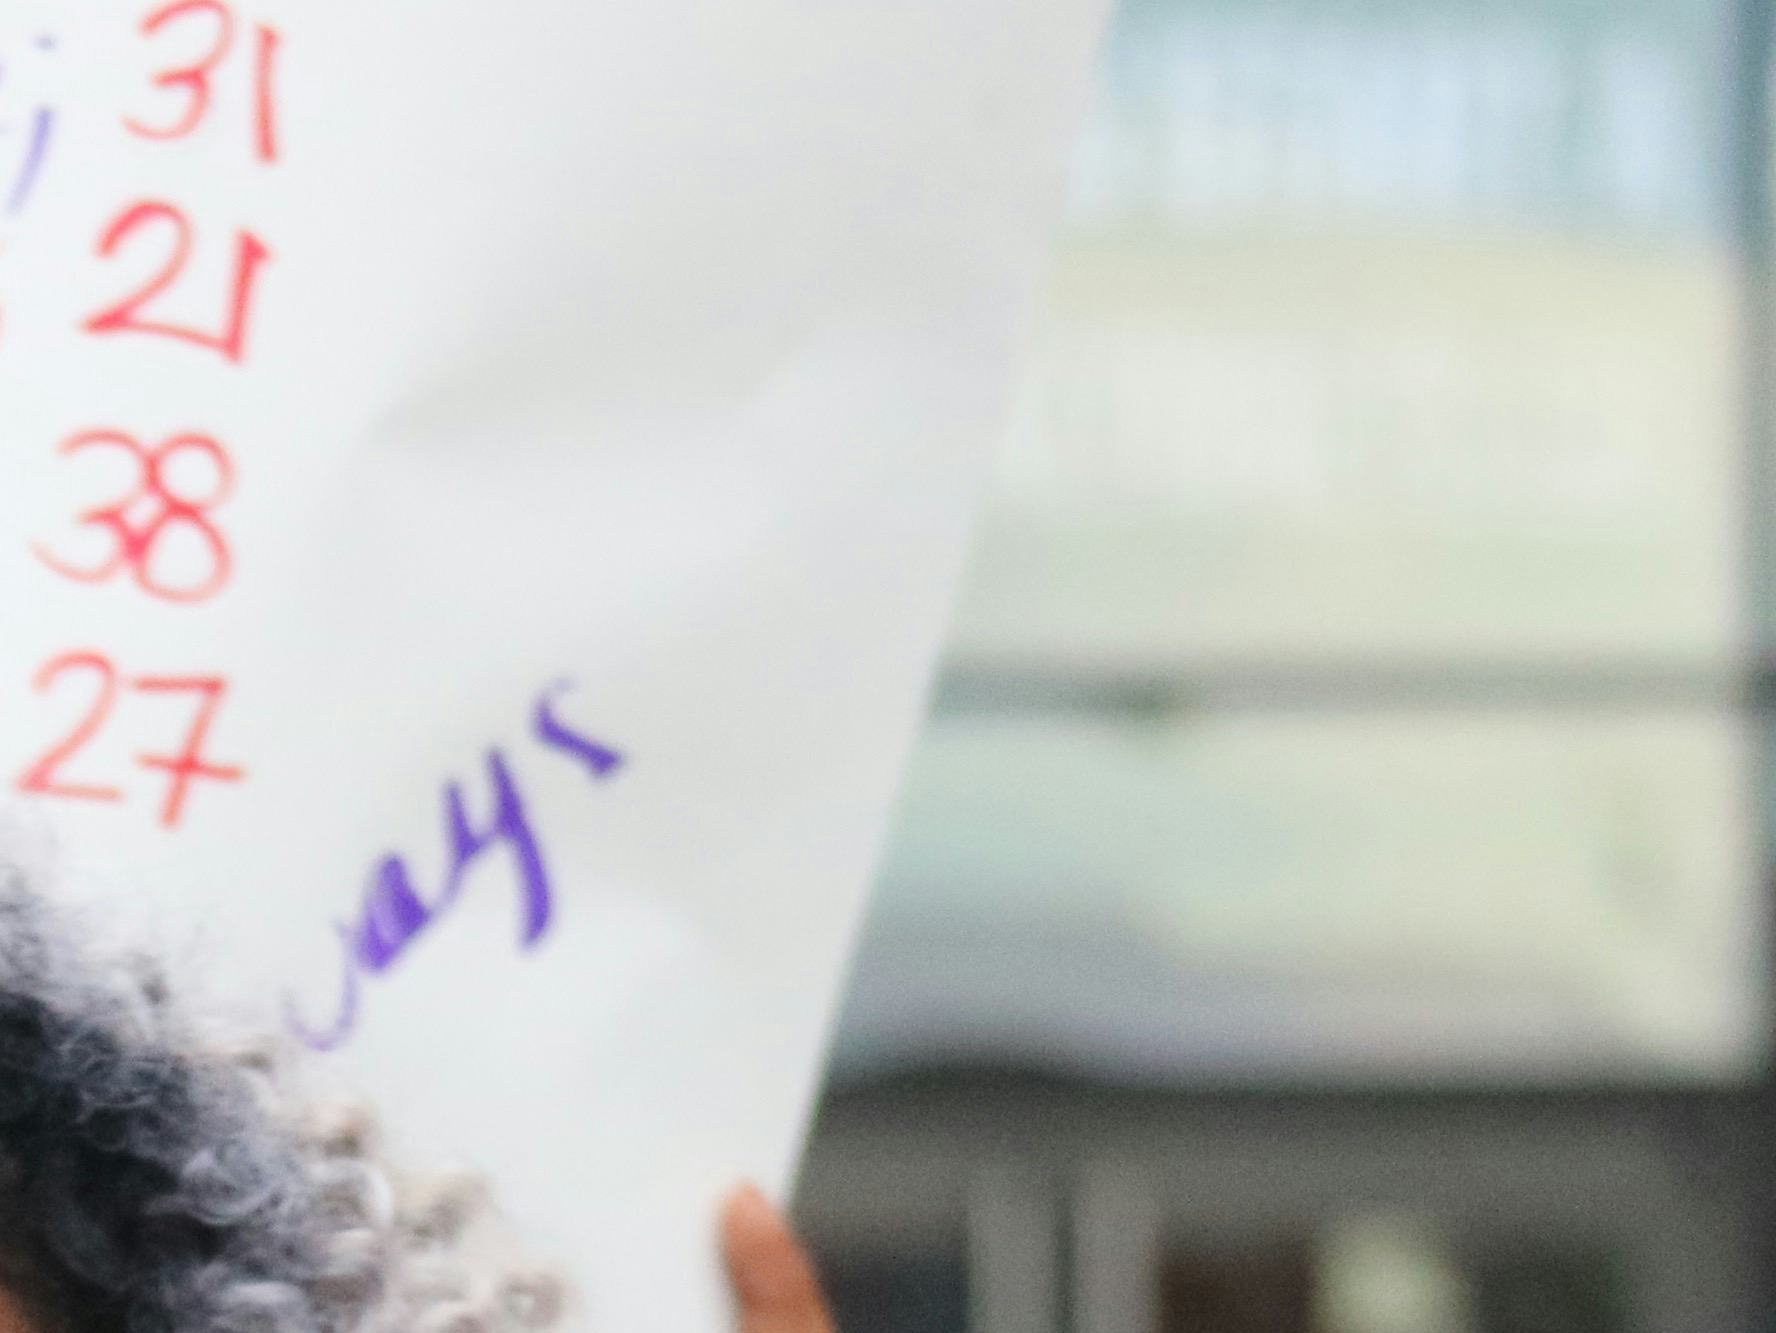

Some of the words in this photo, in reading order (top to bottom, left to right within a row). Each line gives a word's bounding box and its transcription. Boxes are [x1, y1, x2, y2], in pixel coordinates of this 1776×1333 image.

[120, 0, 284, 163] 31
[78, 198, 275, 365] 21
[30, 428, 236, 603] 38
[13, 650, 247, 832] 27
